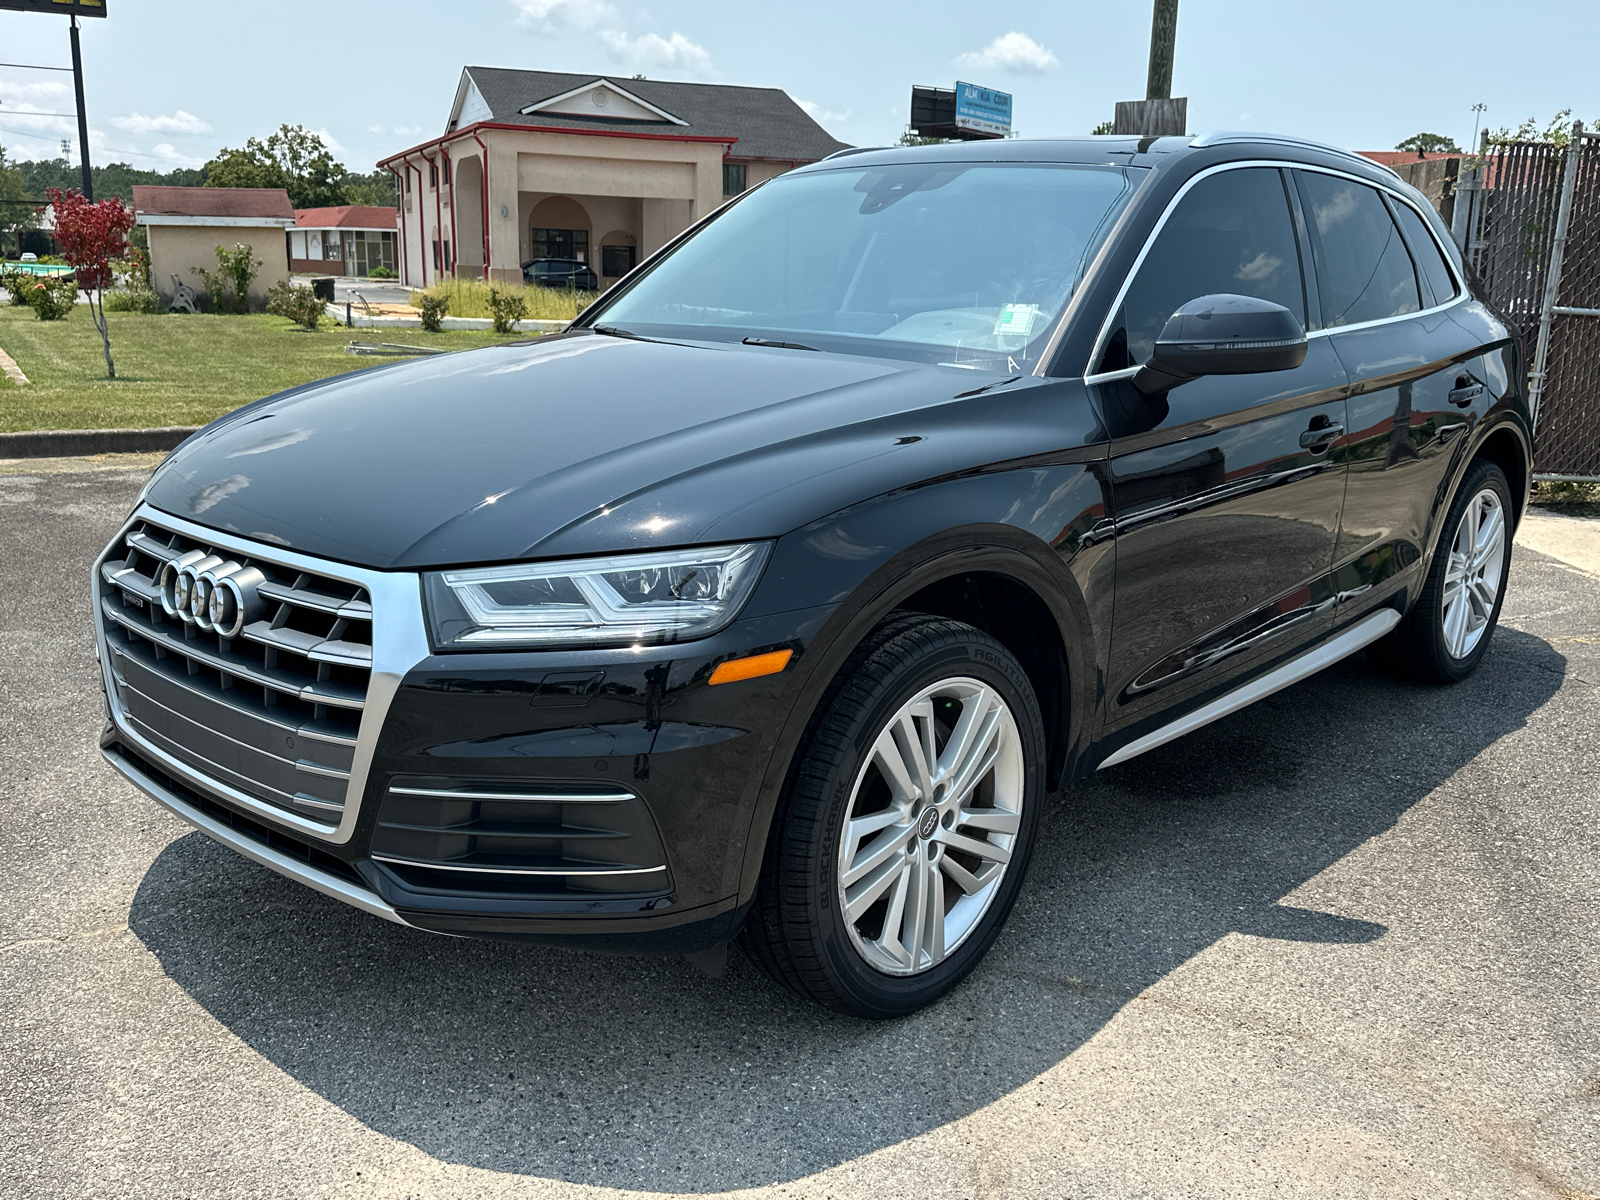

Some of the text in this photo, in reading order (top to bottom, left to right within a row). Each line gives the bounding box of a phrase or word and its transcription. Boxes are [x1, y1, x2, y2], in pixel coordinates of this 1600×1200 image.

[964, 87, 978, 100] ALM
[980, 91, 990, 102] KIA
[973, 648, 1023, 688] AGILITY
[1022, 686, 1039, 724] UHP
[820, 779, 848, 911] BLACKHAWK
